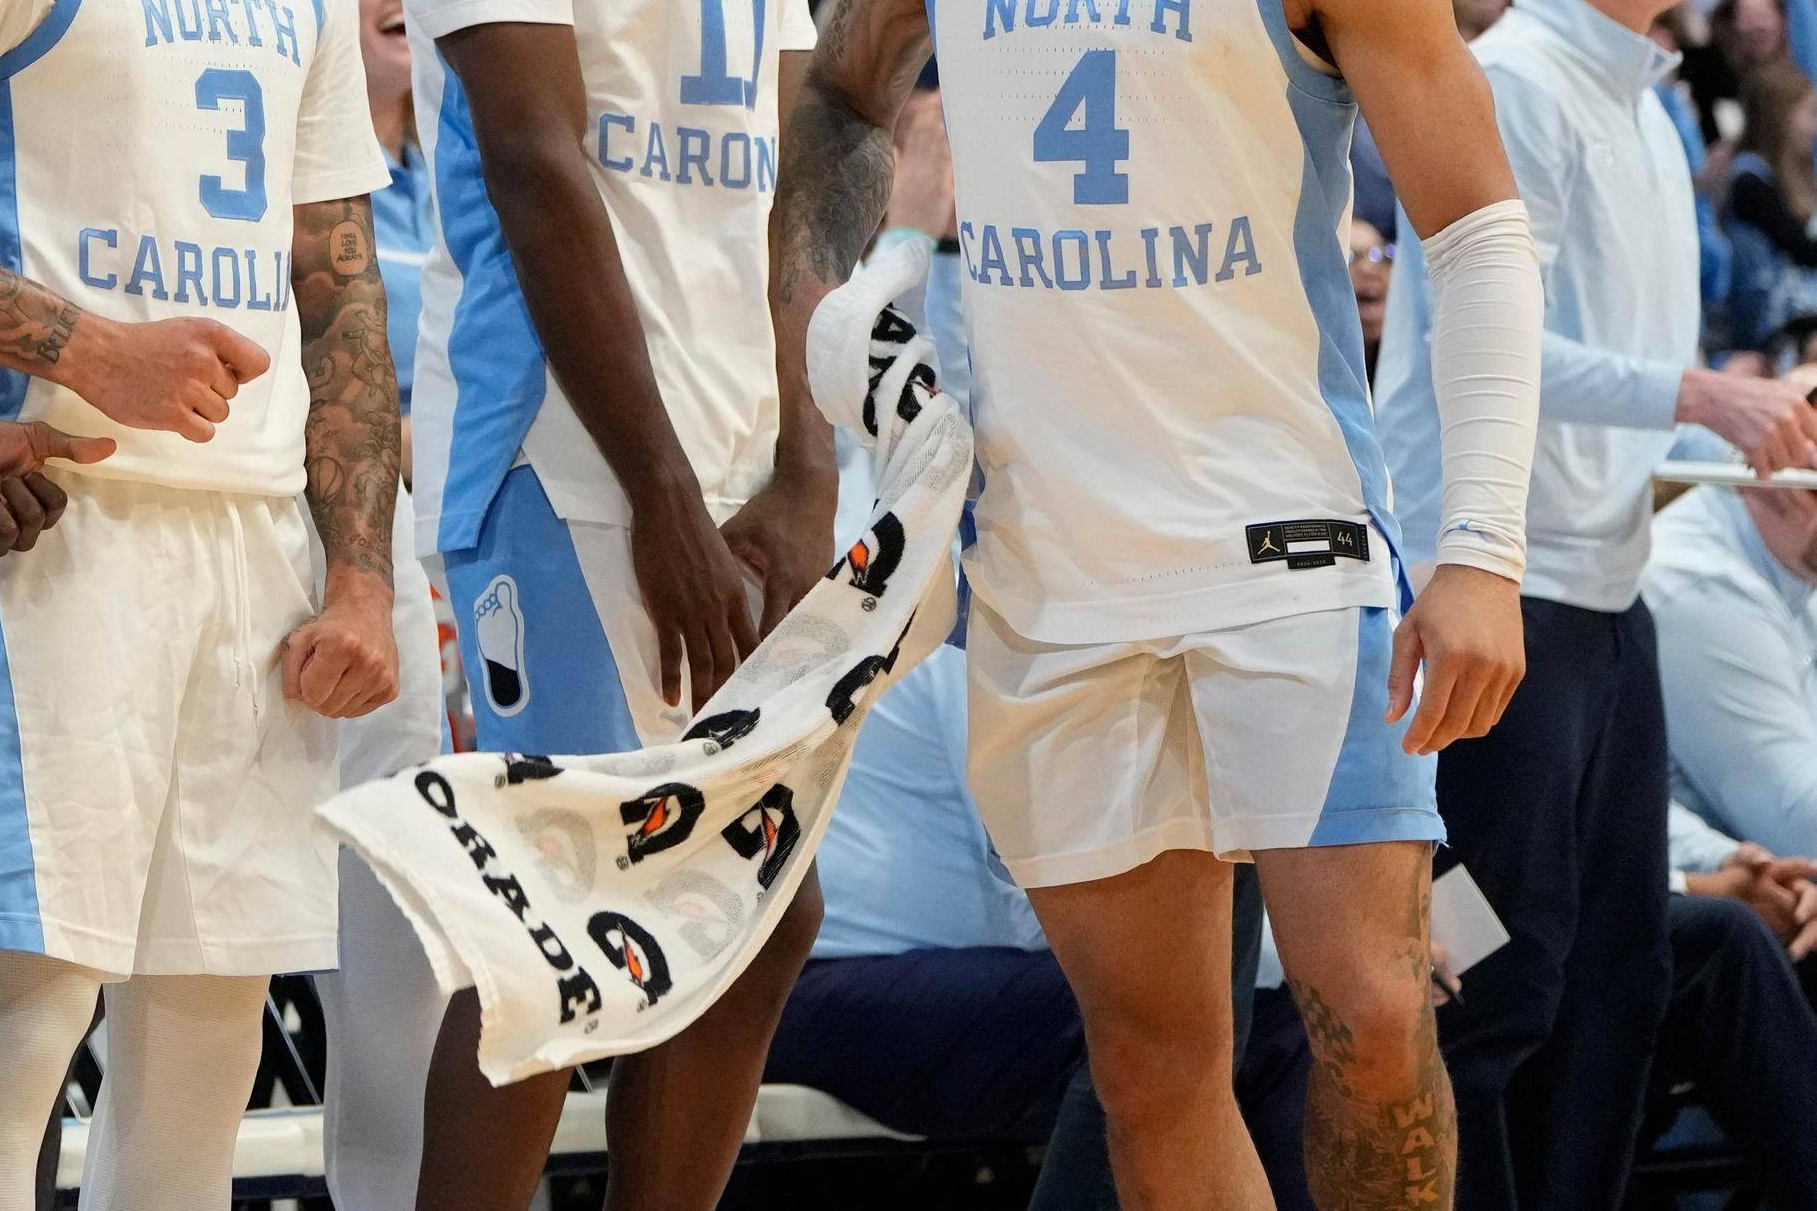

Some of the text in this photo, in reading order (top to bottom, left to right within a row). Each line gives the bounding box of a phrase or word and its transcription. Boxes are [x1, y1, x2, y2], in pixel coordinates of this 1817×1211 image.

[195, 68, 268, 223] 3
[1033, 50, 1129, 205] 4
[79, 227, 292, 313] CAROLI
[960, 215, 1262, 290] CAROLINA
[1337, 531, 1353, 547] 44
